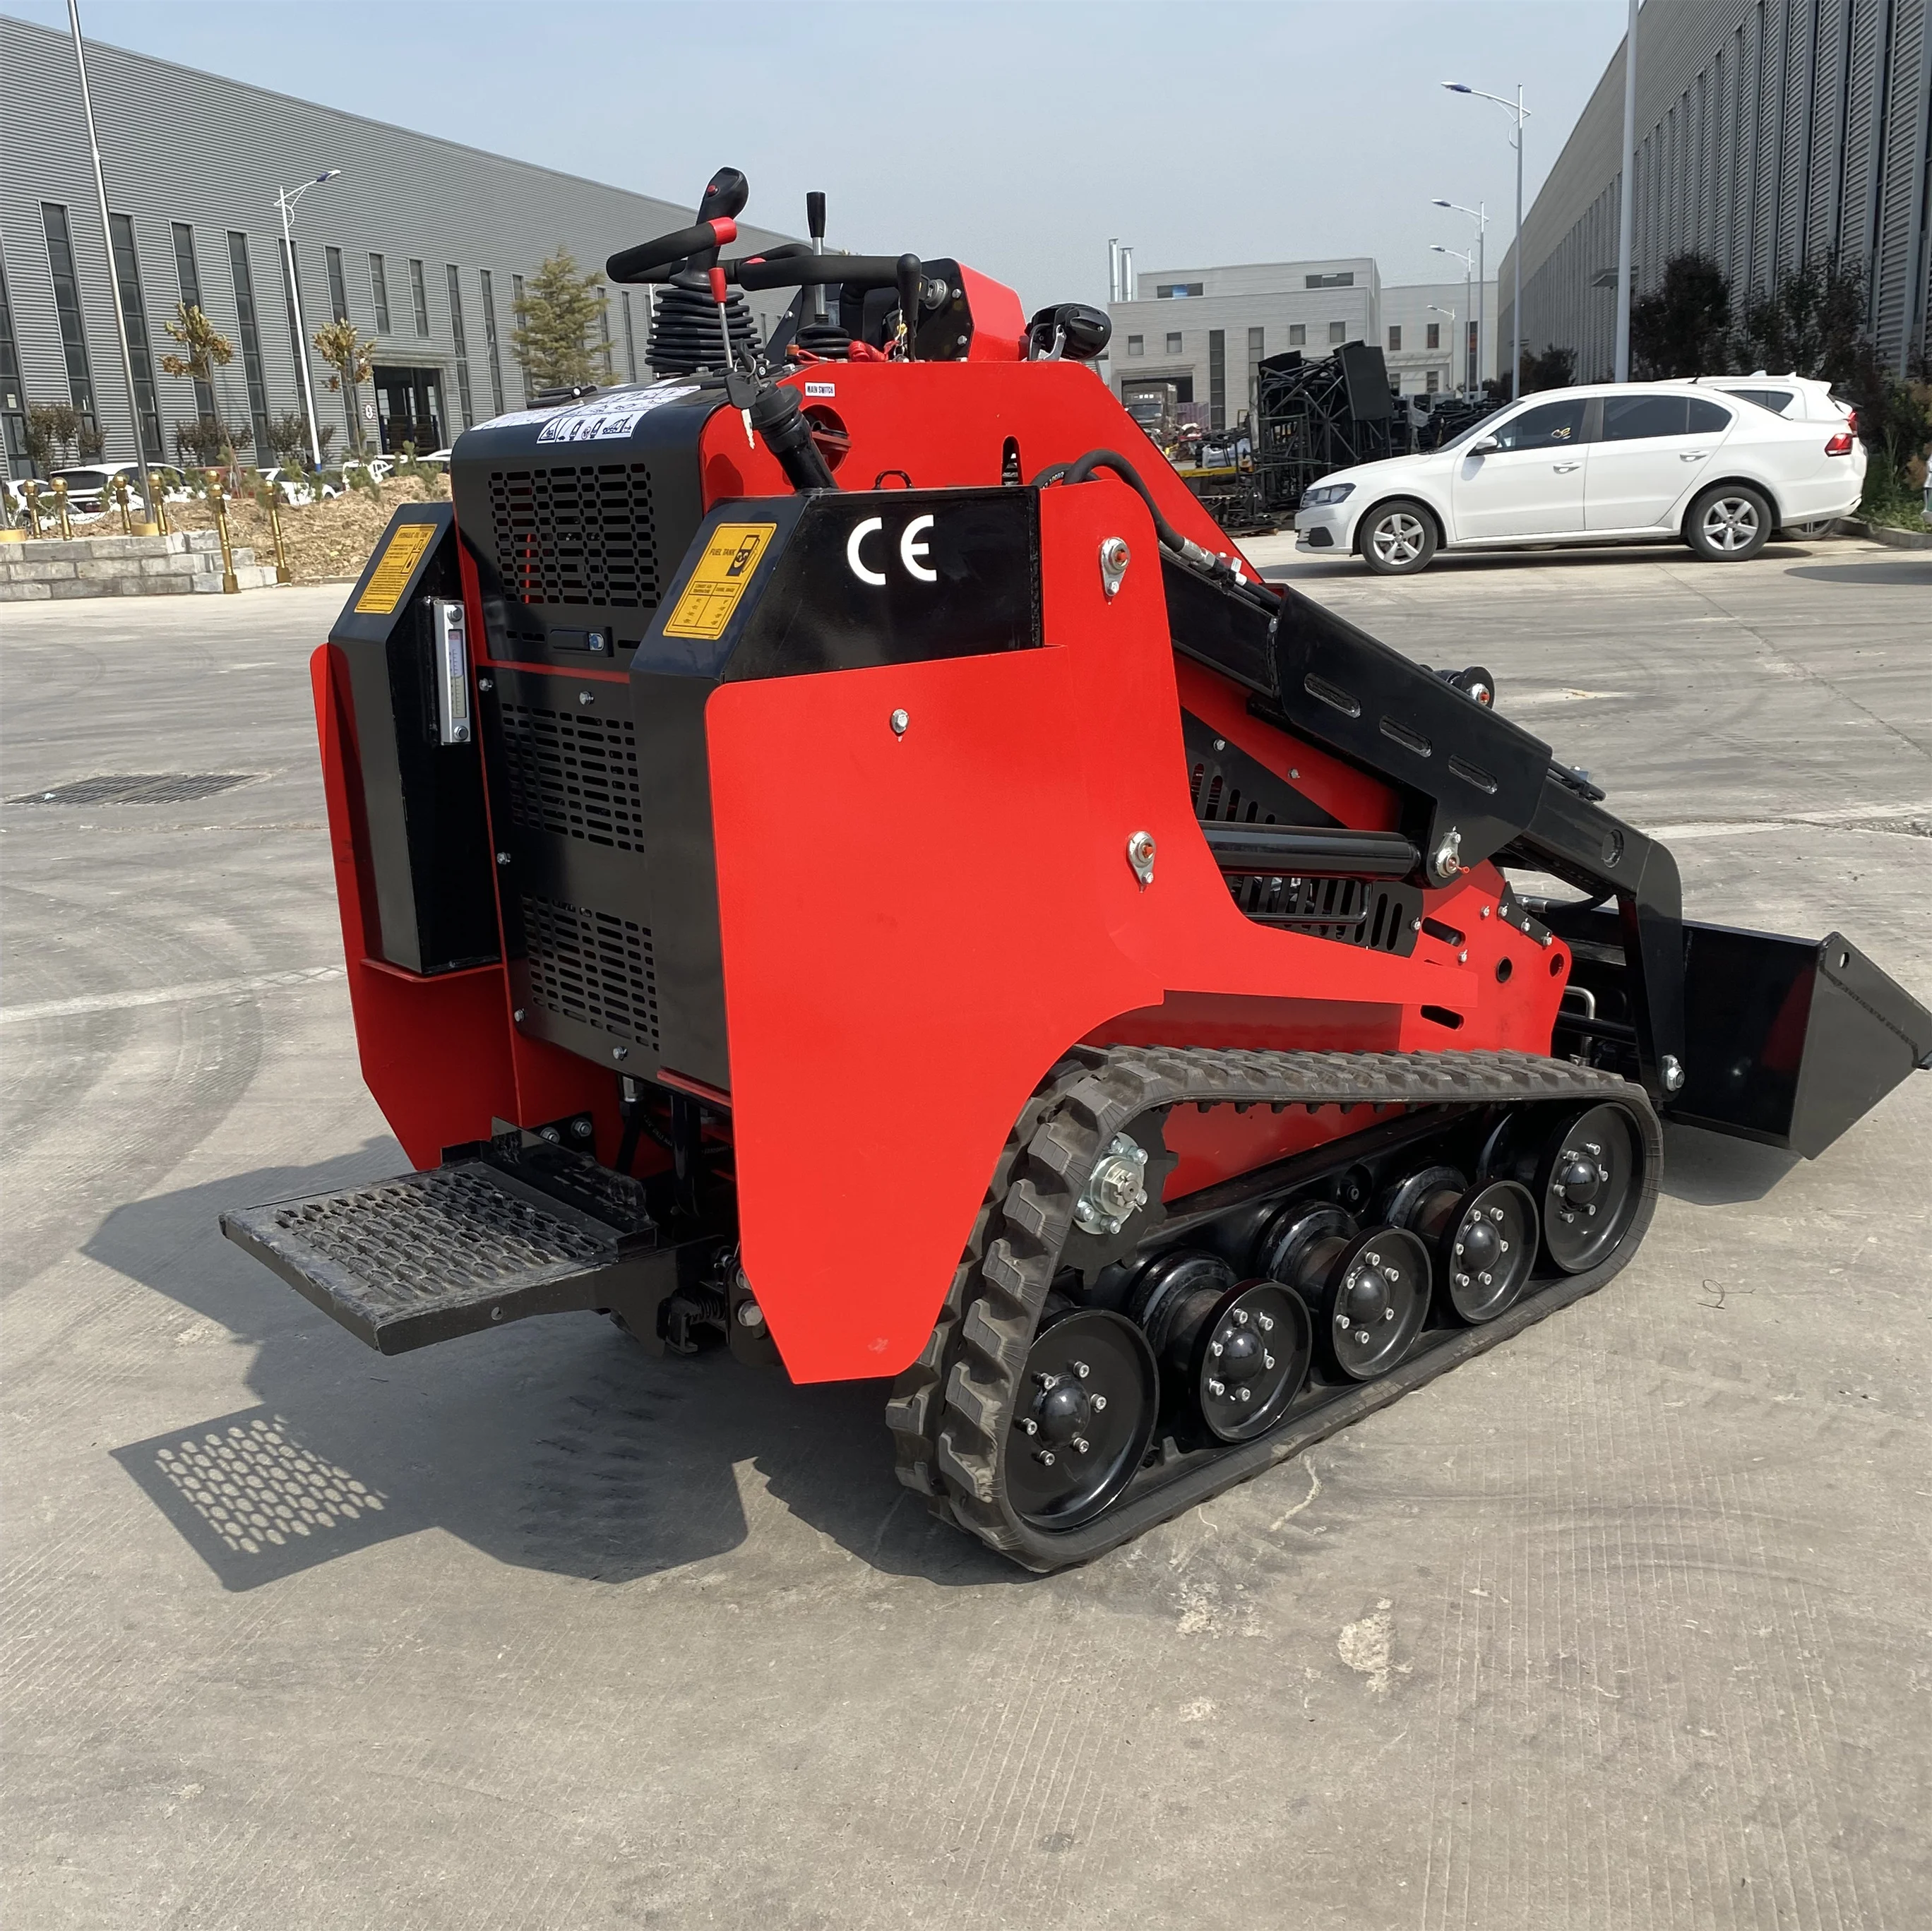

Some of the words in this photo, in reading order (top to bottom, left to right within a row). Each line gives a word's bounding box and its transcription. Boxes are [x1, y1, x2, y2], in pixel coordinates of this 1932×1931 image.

[709, 548, 722, 556] FUEL
[722, 548, 737, 556] TANK
[847, 514, 937, 585] CE
